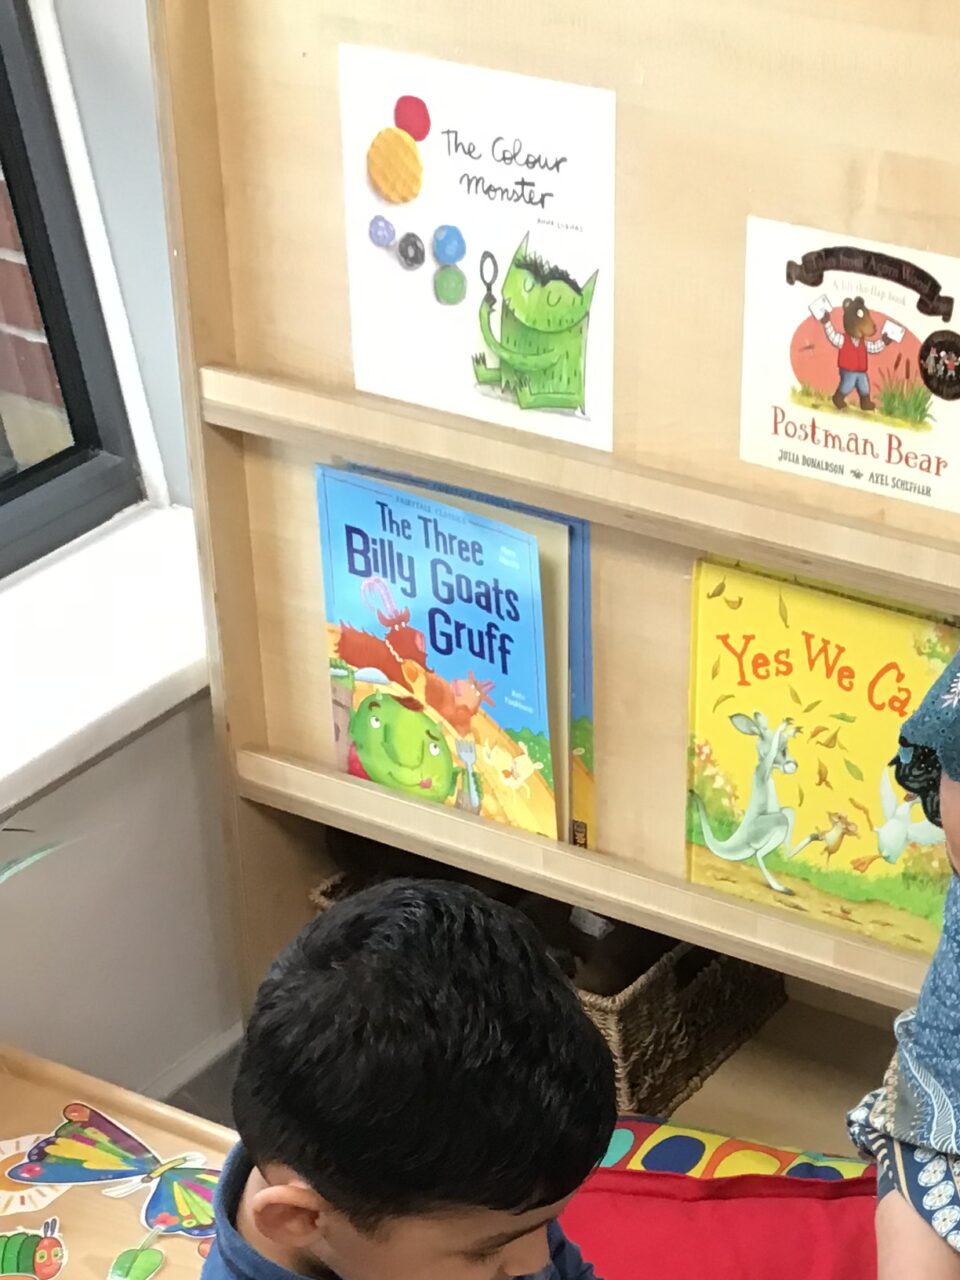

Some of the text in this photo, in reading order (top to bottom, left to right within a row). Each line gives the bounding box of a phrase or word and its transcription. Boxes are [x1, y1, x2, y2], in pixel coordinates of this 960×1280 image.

[441, 129, 568, 173] The Colour
[771, 405, 948, 477] Postman Bear
[778, 449, 800, 464] JULIA
[801, 454, 845, 476] DONALDSON
[868, 472, 889, 487] AXEL
[375, 500, 412, 540] The
[417, 515, 484, 566] Three
[345, 524, 521, 623] Billy Goats
[428, 607, 514, 675] Gruff
[716, 631, 913, 718] Yes We Ca
